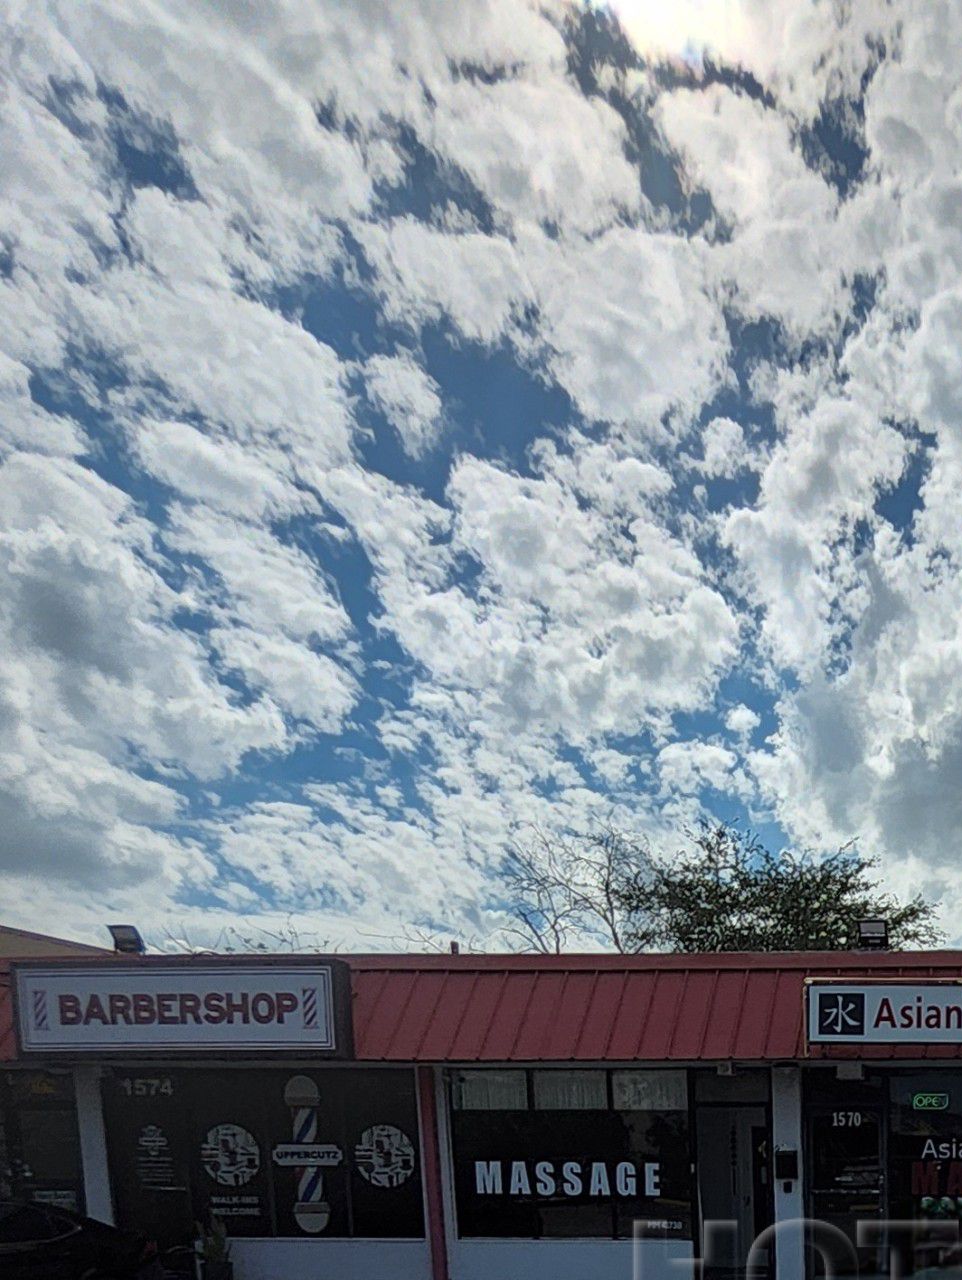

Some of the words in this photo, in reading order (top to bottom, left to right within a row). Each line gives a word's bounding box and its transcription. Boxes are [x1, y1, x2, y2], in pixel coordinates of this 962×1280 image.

[58, 991, 299, 1027] BARBERSHOP
[824, 994, 860, 1033] 水
[873, 996, 962, 1030] Asian
[123, 1077, 174, 1096] 1574
[832, 1111, 862, 1127] 1570
[275, 1150, 339, 1160] UPPERCUTZ
[475, 1160, 661, 1197] MASSAGE
